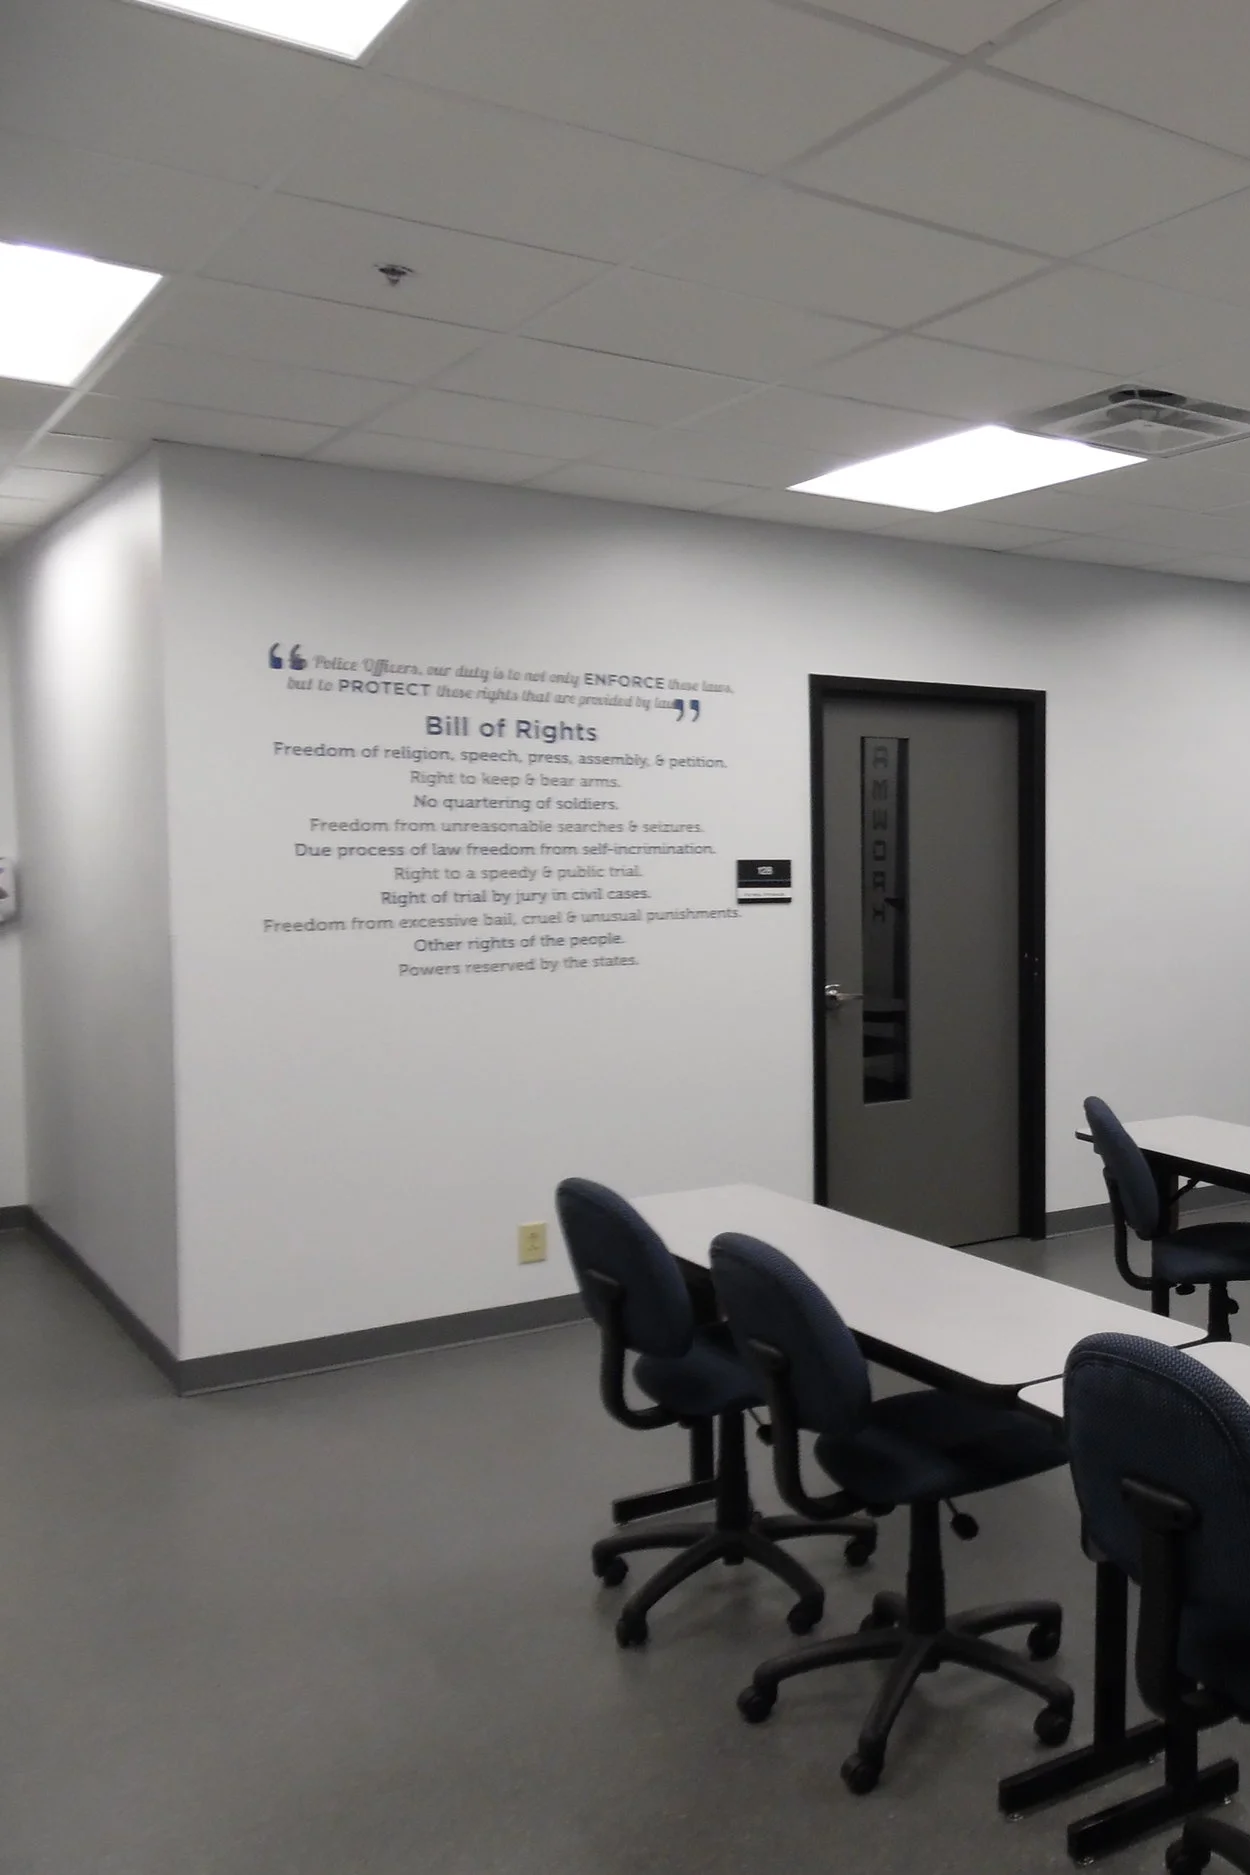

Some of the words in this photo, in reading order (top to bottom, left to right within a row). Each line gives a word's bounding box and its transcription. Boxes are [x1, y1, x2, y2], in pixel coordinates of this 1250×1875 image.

[313, 655, 357, 671] Police
[362, 658, 422, 676] Officers,
[427, 666, 451, 676] our
[455, 665, 489, 682] duty
[524, 670, 547, 682] not
[549, 672, 579, 687] only
[584, 673, 665, 689] ENFORCE
[287, 677, 312, 690] but
[318, 679, 333, 691] to
[338, 679, 431, 696] PROTECT
[476, 689, 517, 703] rights
[522, 690, 549, 701] that
[554, 694, 575, 704] are
[578, 694, 631, 707] provided
[636, 697, 650, 710] by
[426, 715, 468, 736] Bill
[479, 718, 506, 738] of
[516, 720, 597, 743] Rights
[274, 742, 355, 757] Freedom
[361, 745, 379, 758] of
[385, 747, 455, 762] religion,
[461, 749, 522, 764] speech,
[528, 754, 572, 766] press,
[579, 754, 650, 768] assembly,
[656, 755, 664, 765] &
[669, 756, 728, 770] petition.
[410, 771, 454, 786] Right
[461, 772, 476, 784] to
[482, 772, 520, 787] keep
[525, 774, 535, 785] &
[541, 774, 574, 787] bear
[580, 777, 621, 787] arms.
[413, 795, 437, 808] No
[443, 797, 530, 812] quartering
[536, 798, 551, 809] of
[556, 799, 618, 810] soldiers.
[310, 818, 388, 832] Freedom
[394, 820, 435, 832] from
[441, 821, 552, 832] unreasonable
[559, 821, 623, 833] searches
[629, 821, 637, 832] &
[642, 821, 705, 833] seizures.
[294, 843, 331, 856] Due
[338, 845, 404, 859] process
[410, 843, 427, 856] of
[432, 843, 460, 855] law
[466, 843, 535, 855] freedom
[540, 843, 578, 854] from
[583, 843, 716, 854] self-incrimination.
[394, 867, 438, 883] Right
[445, 868, 460, 879] to
[466, 870, 476, 879] a
[481, 867, 536, 882] speedy
[542, 867, 552, 878] &
[557, 866, 604, 881] public
[610, 865, 642, 877] trial.
[381, 892, 426, 907] Right
[432, 891, 448, 904] of
[454, 890, 486, 903] trial
[492, 890, 510, 904] by
[516, 890, 547, 904] jury
[552, 889, 566, 900] in
[572, 888, 602, 900] civil
[607, 889, 651, 900] cases.
[263, 918, 346, 932] Freedom
[352, 917, 393, 930] from
[399, 914, 478, 928] excessive
[484, 913, 516, 926] bail,
[522, 913, 561, 924] cruel
[567, 912, 576, 923] &
[582, 910, 640, 922] unusual
[647, 907, 741, 923] punishments.
[414, 939, 461, 951] Other
[468, 936, 514, 952] rights
[520, 935, 535, 947] of
[541, 934, 564, 947] the
[570, 933, 624, 947] people.
[399, 963, 460, 976] Powers
[465, 959, 535, 973] reserved
[540, 958, 557, 972] by
[564, 957, 587, 968] the
[592, 955, 639, 967] states.
